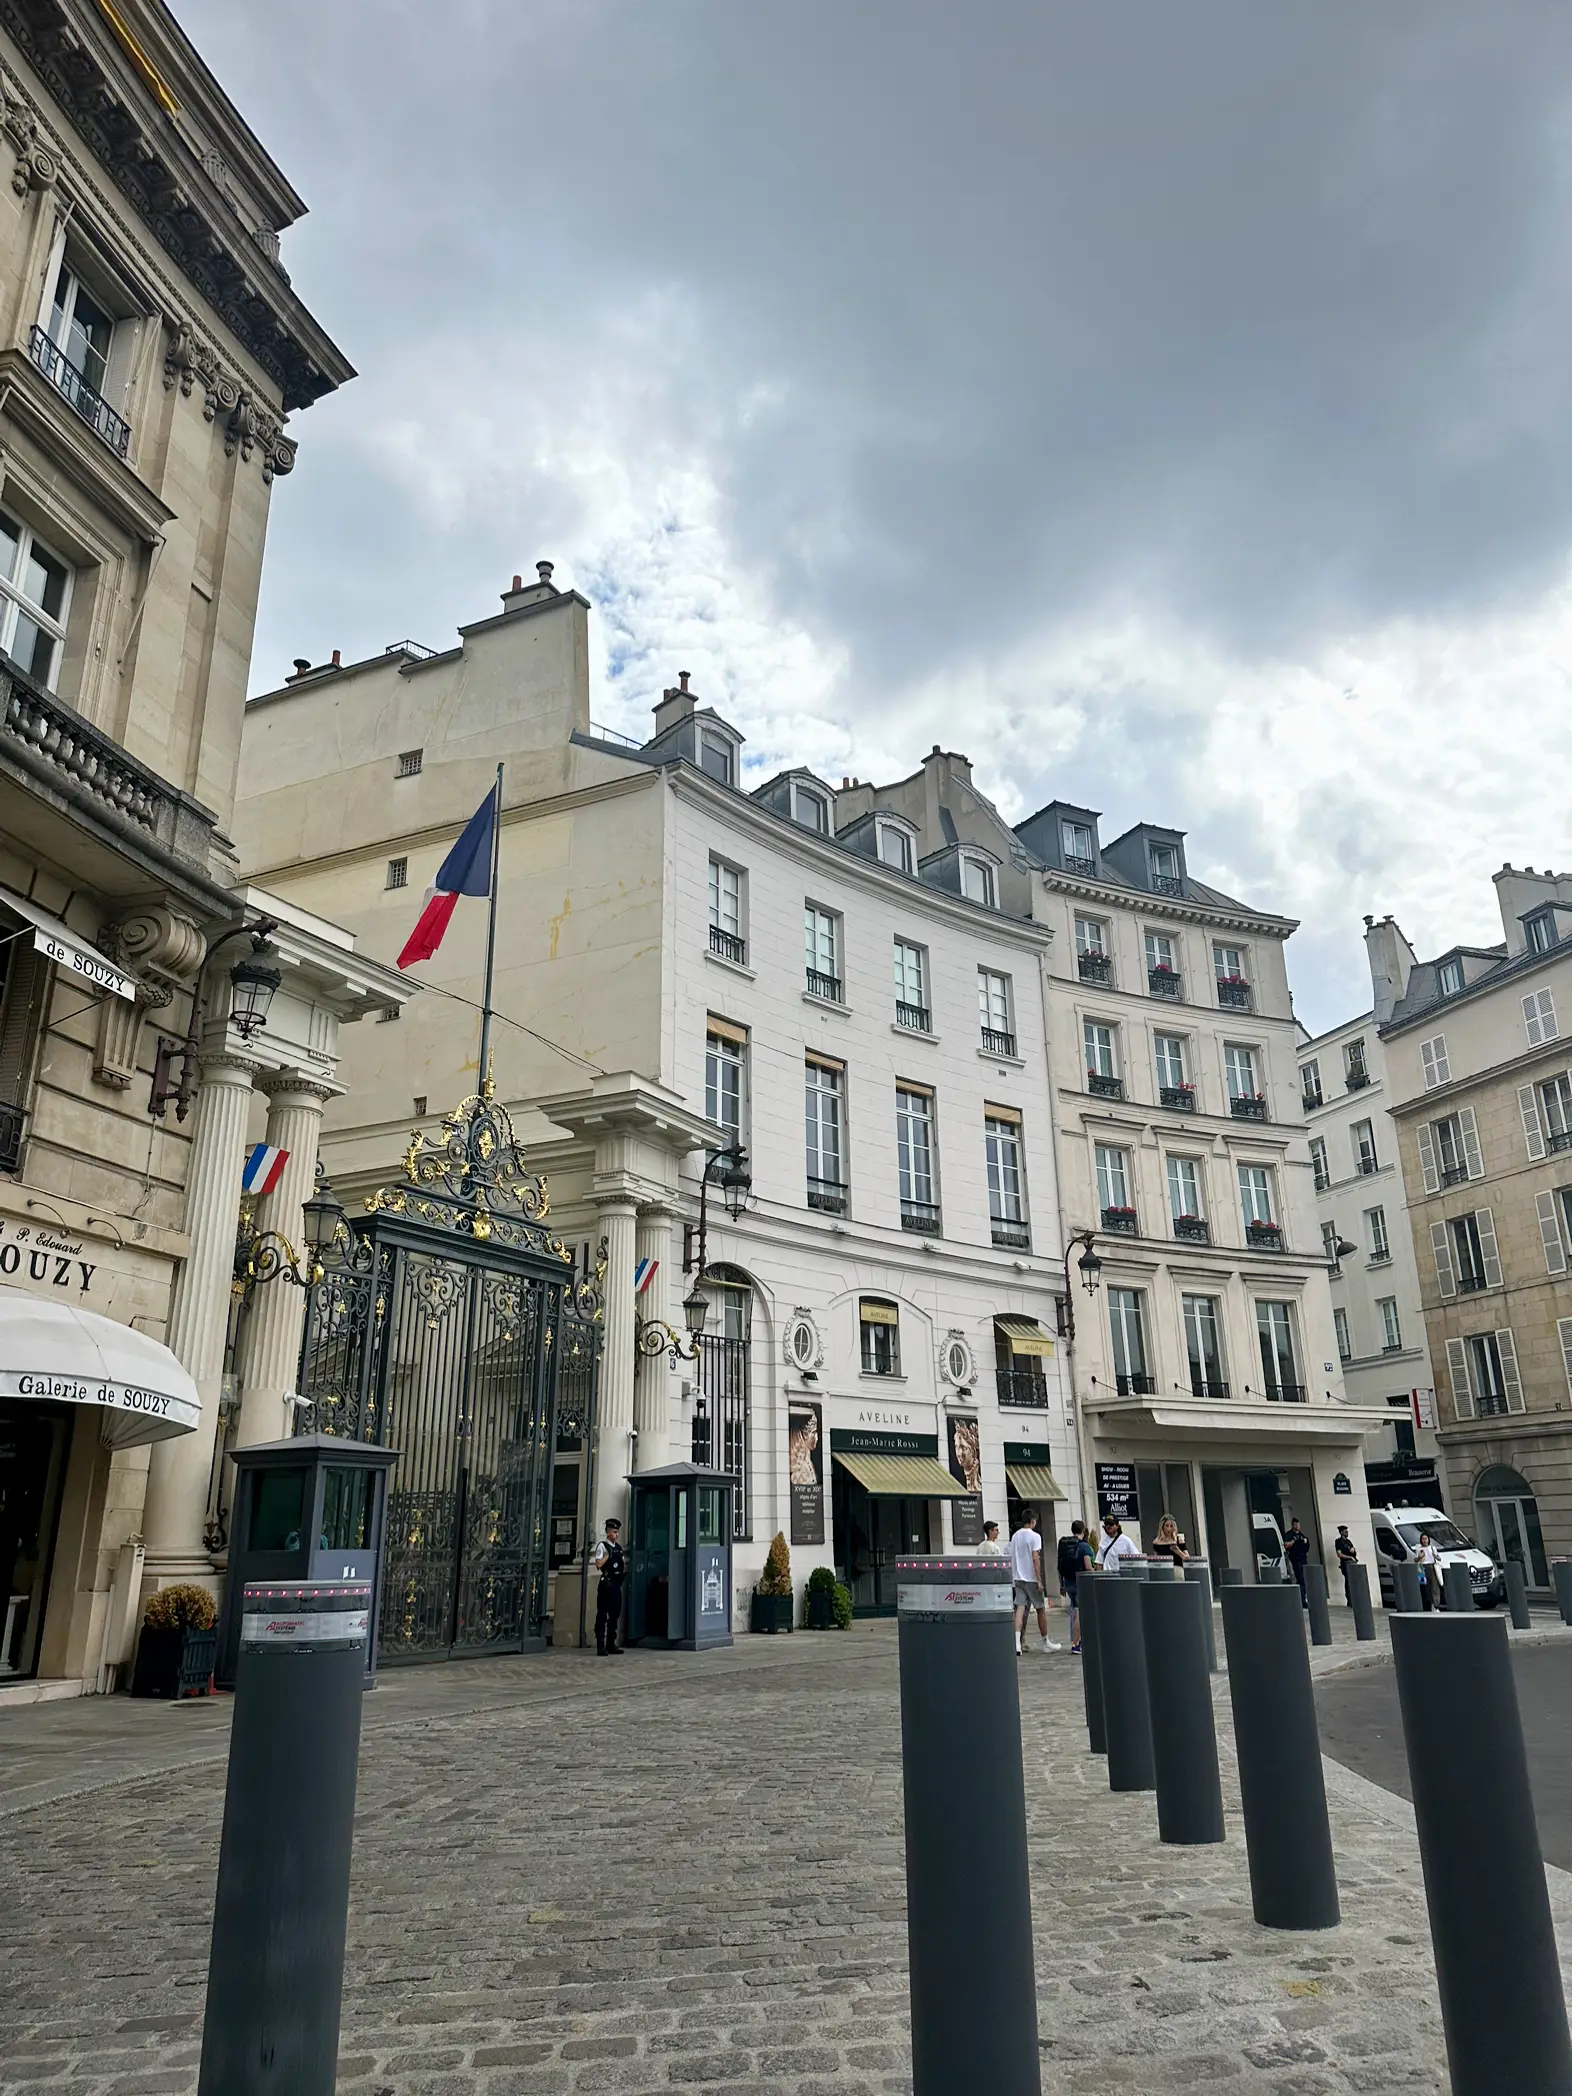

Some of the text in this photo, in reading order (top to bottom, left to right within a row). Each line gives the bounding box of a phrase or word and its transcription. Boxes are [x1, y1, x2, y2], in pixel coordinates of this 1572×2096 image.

[46, 940, 126, 993] de SOUZY
[812, 1194, 841, 1207] AVELINE
[905, 1216, 934, 1228] AVELINE
[16, 1227, 29, 1242] P.
[36, 1232, 83, 1256] Edouard
[997, 1233, 1025, 1244] AVELINE
[0, 1244, 97, 1291] OUZY
[870, 1311, 889, 1320] AVELINE
[1024, 1345, 1043, 1353] AVELINE
[18, 1375, 171, 1416] Galerie de SOUZY
[859, 1412, 910, 1425] AVELINE
[850, 1436, 919, 1449] Jean-Marie Rossi
[1022, 1448, 1031, 1457] 94
[1106, 1493, 1119, 1501] 534
[1110, 1503, 1128, 1512] Alliot
